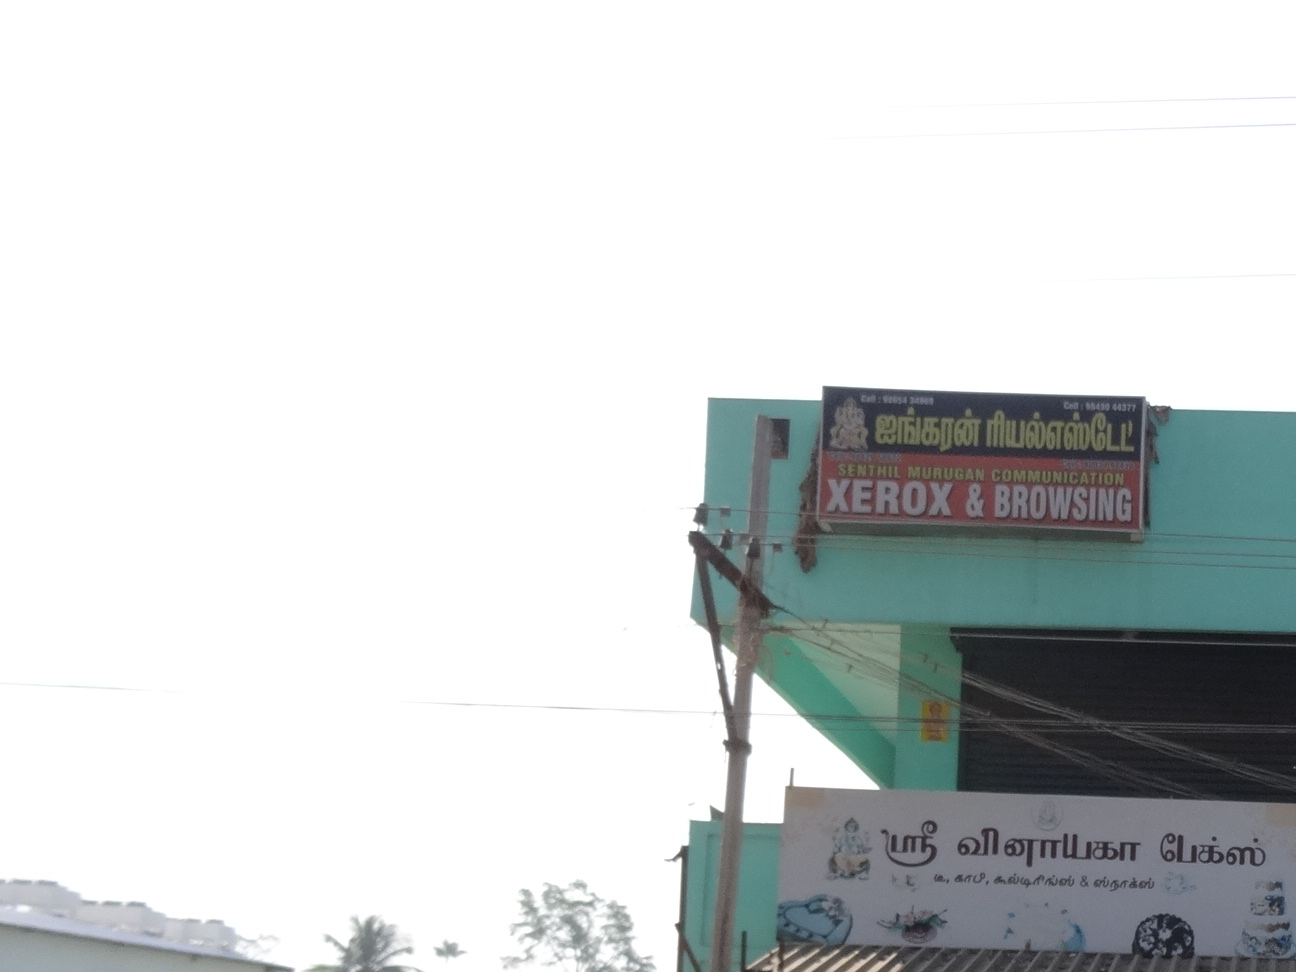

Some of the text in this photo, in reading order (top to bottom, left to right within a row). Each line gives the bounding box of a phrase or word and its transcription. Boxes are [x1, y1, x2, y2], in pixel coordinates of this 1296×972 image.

[875, 407, 981, 452] ஐங்கரன்
[838, 463, 1125, 486] SENTHIL MURUGAN COMMUNICATION
[826, 477, 1132, 522] XEROX & BROWSING
[881, 820, 938, 868] ஸ்ரீ
[1160, 832, 1267, 867] பேக்ஸ்
[1080, 875, 1090, 887] &
